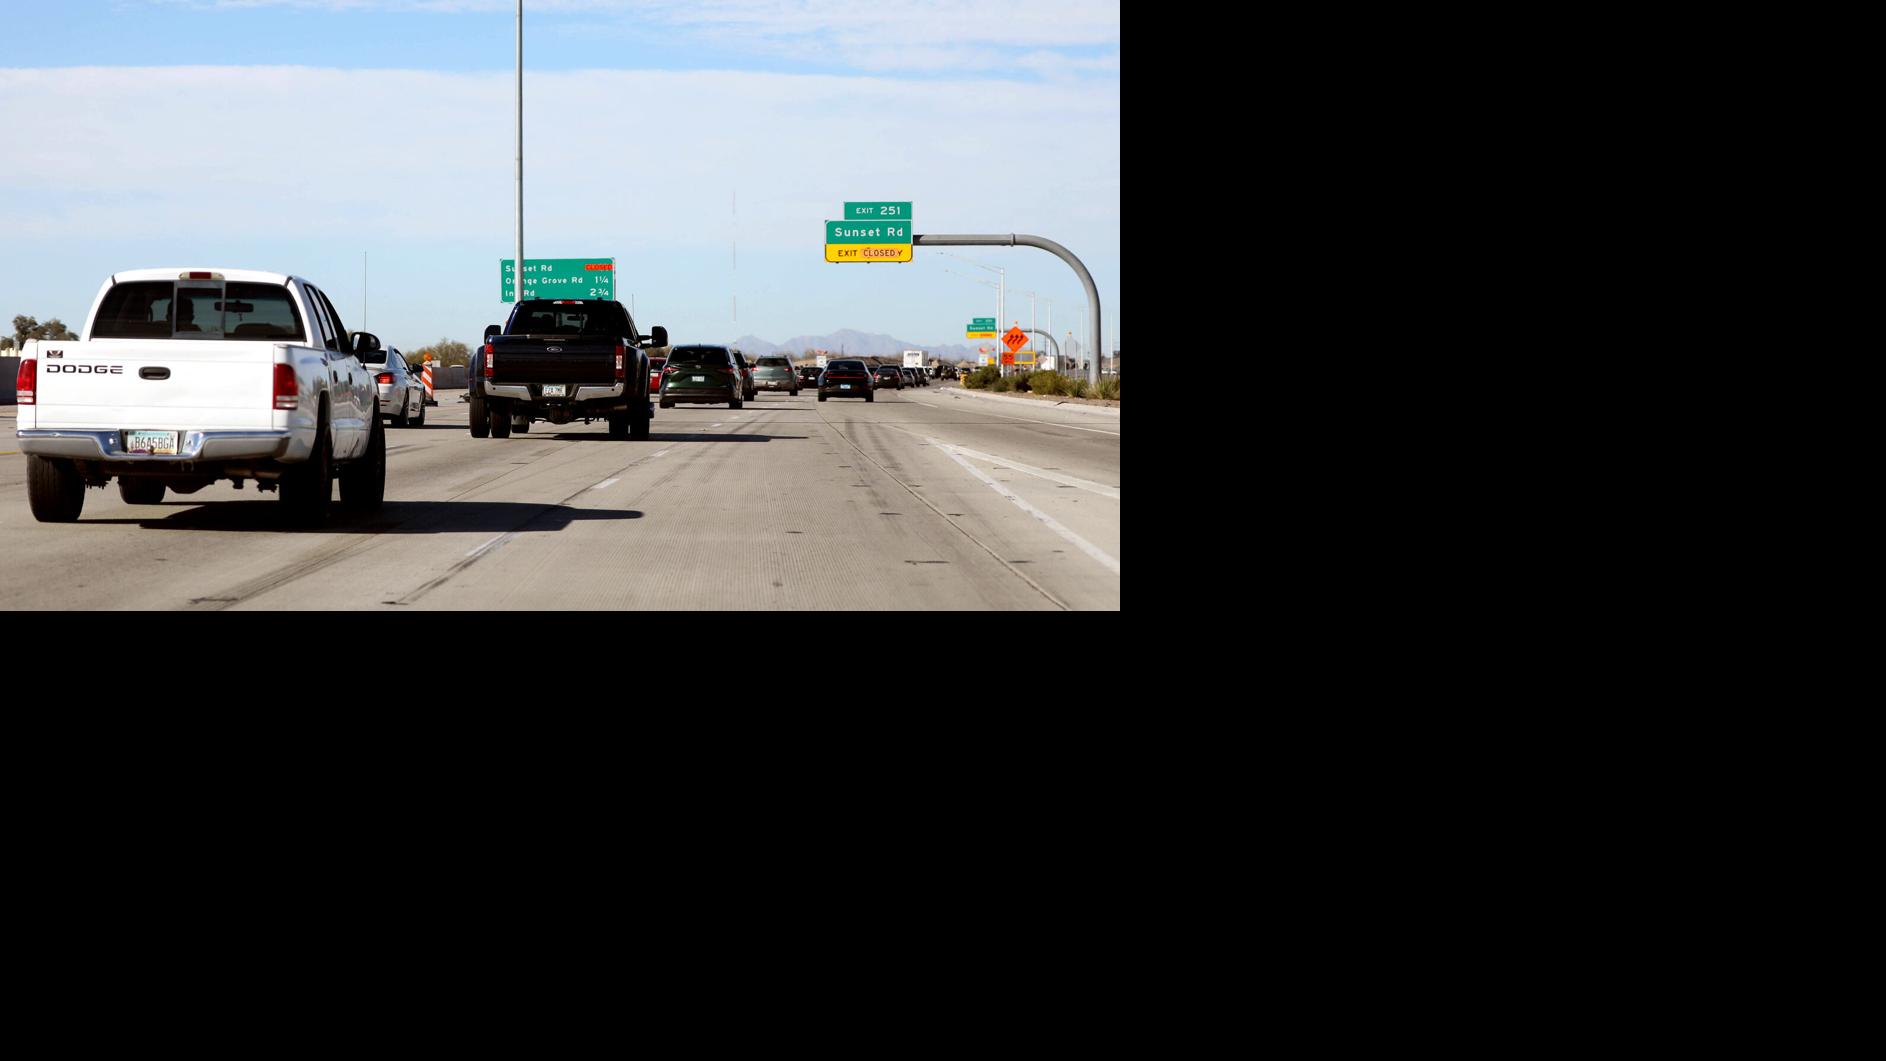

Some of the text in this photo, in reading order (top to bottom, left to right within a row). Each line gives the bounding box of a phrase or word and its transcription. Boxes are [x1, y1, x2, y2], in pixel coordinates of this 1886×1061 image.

[880, 206, 901, 215] 251
[835, 227, 903, 237] Sunset Rd
[838, 249, 858, 257] EXIT
[863, 249, 895, 257] CLOSED
[505, 277, 538, 285] Ornge
[46, 364, 124, 375] DODGE
